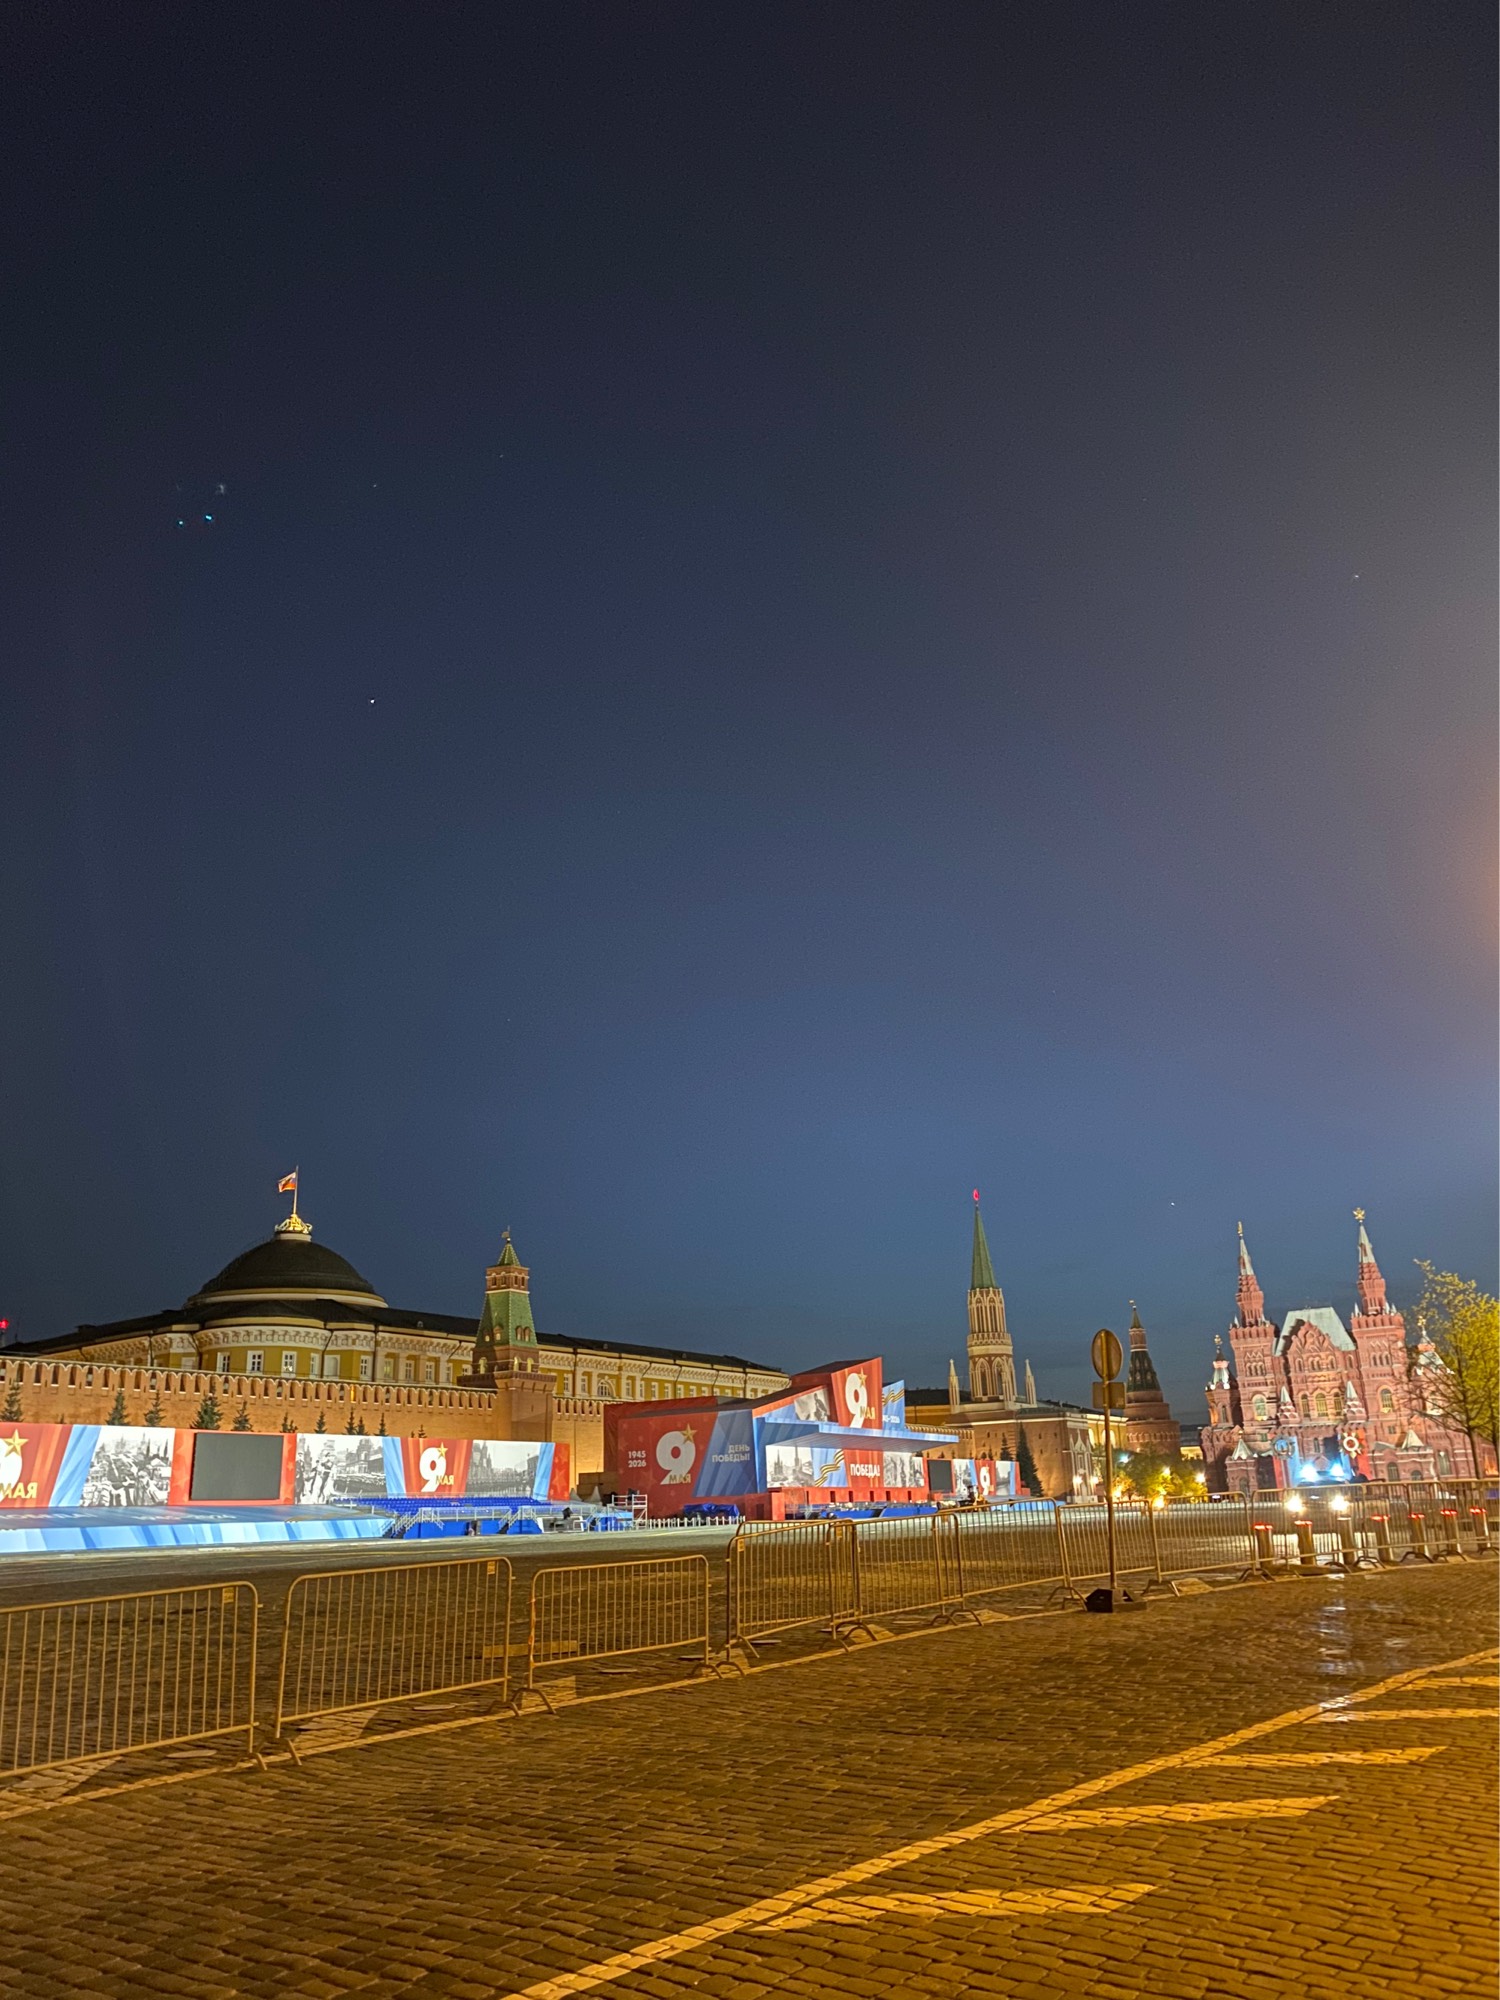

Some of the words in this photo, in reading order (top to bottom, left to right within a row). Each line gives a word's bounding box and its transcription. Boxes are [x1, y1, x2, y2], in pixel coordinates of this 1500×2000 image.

[844, 1372, 868, 1428] 9
[860, 1407, 875, 1419] МАЯ
[628, 1450, 646, 1459] 1945
[728, 1444, 750, 1453] ДЕНЬ
[656, 1430, 696, 1485] 9
[712, 1453, 750, 1463] ПОБЕДЫ!
[419, 1447, 446, 1492] 9
[628, 1460, 646, 1468] 2026
[850, 1464, 880, 1477] ПОБЕДА!
[436, 1475, 454, 1485] МАЯ
[669, 1474, 691, 1484] МАЯ
[980, 1466, 990, 1495] 9
[0, 1482, 38, 1498] МАЯ
